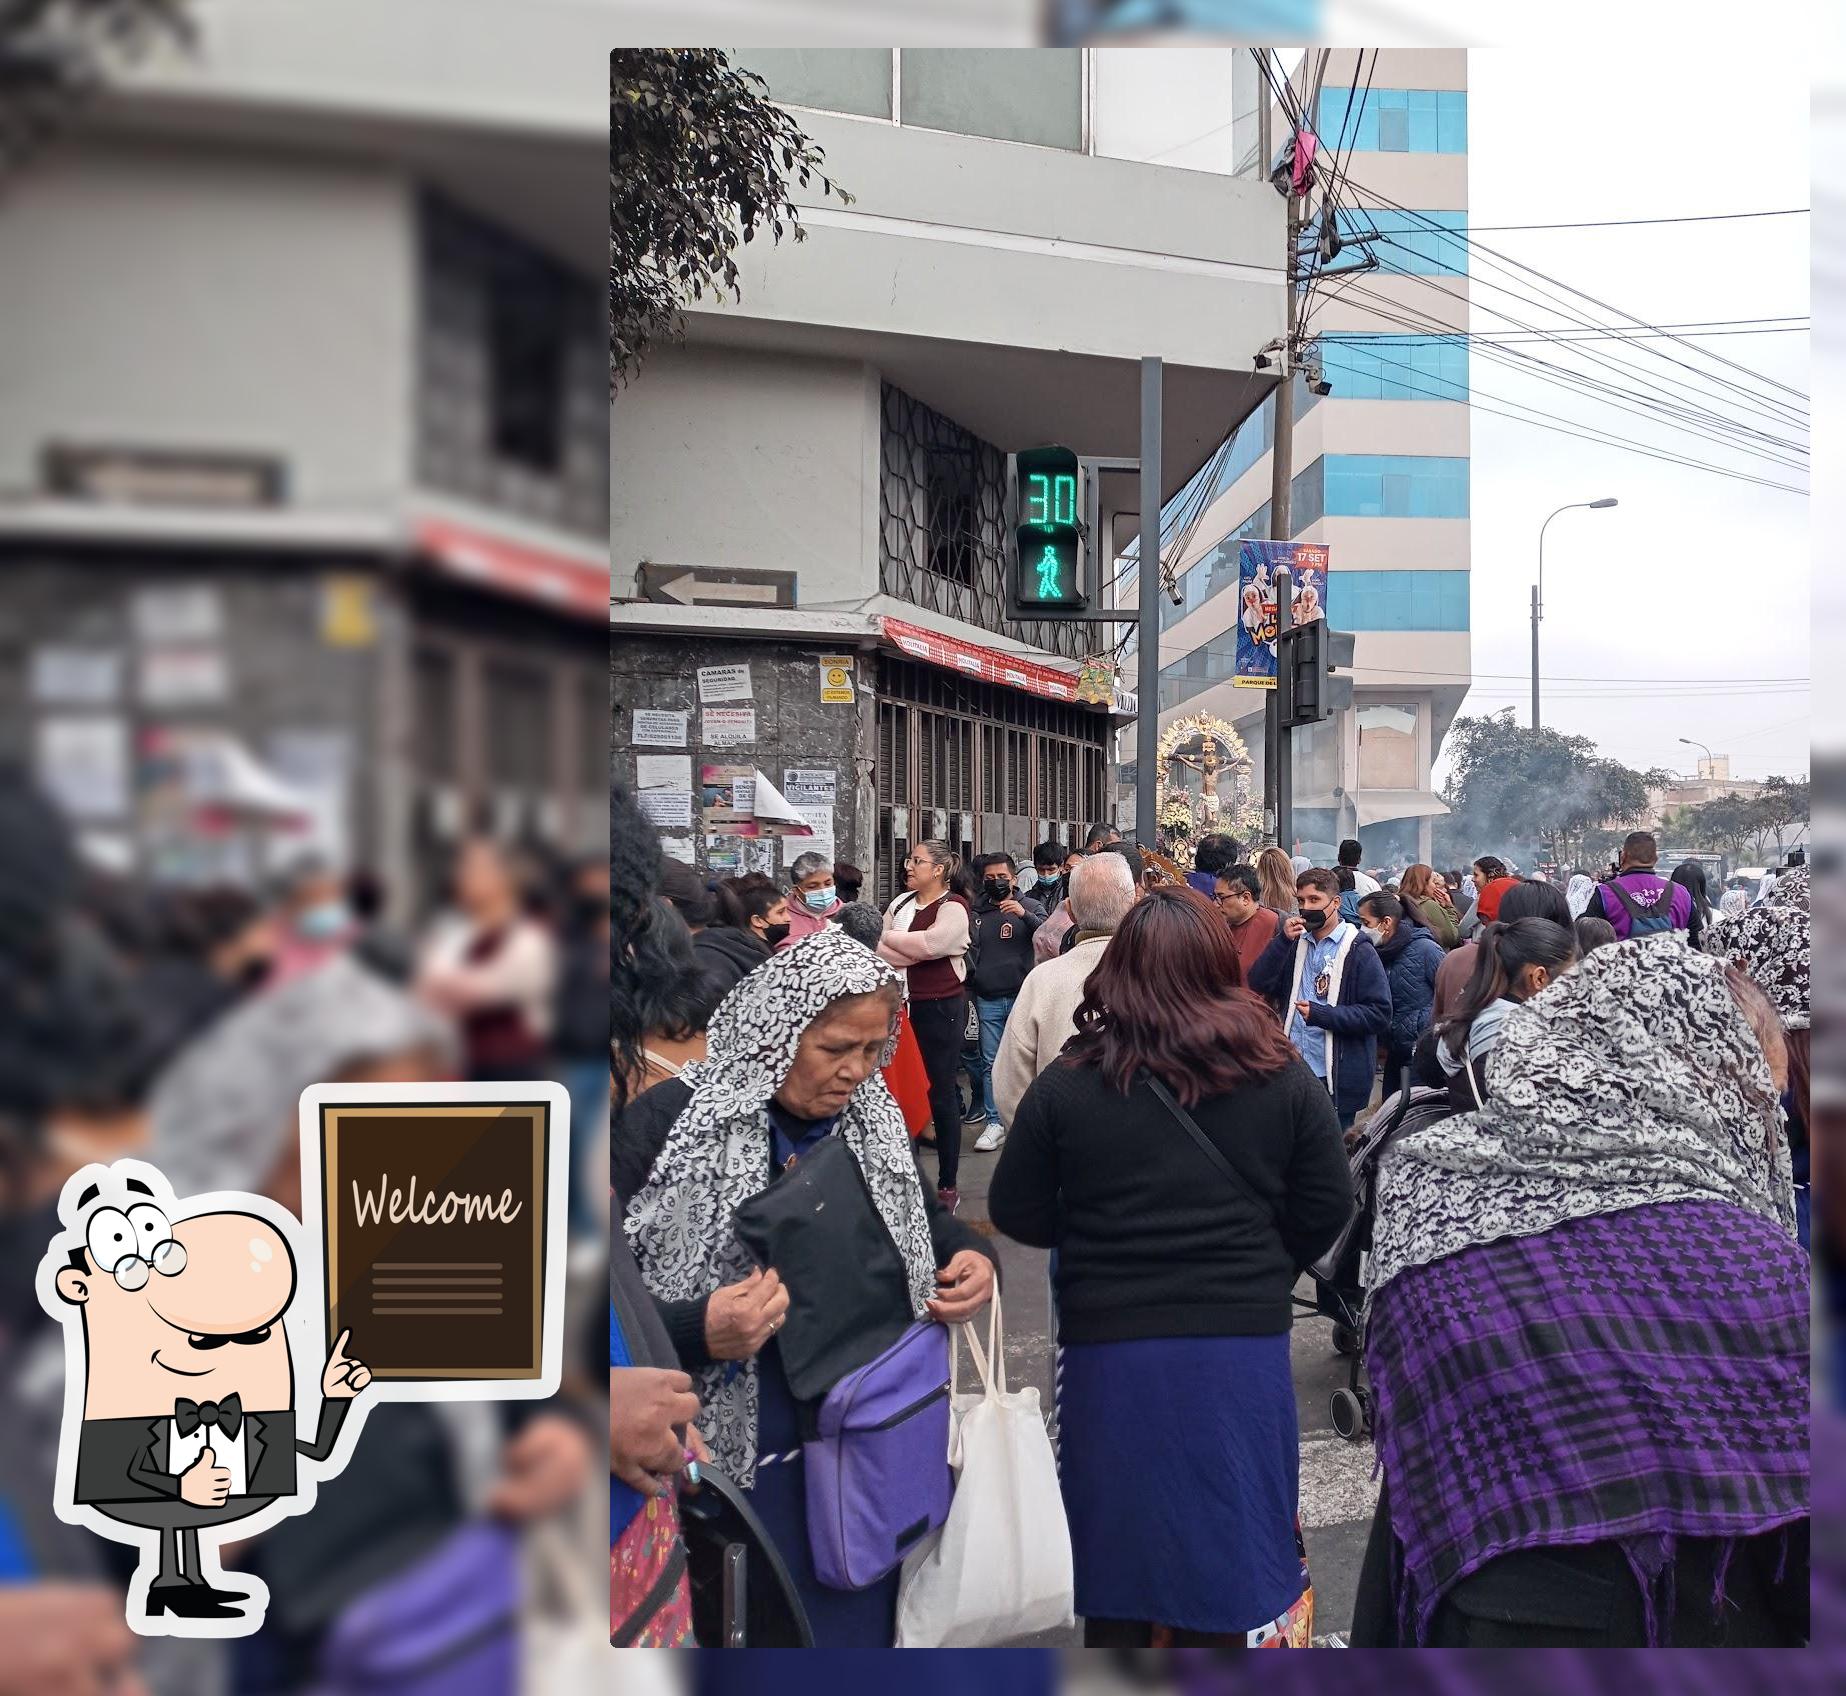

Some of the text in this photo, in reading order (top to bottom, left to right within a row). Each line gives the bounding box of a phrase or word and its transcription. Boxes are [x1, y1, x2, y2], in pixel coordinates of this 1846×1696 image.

[1029, 474, 1075, 524] 30
[1297, 552, 1307, 562] 17
[1308, 553, 1327, 563] SET
